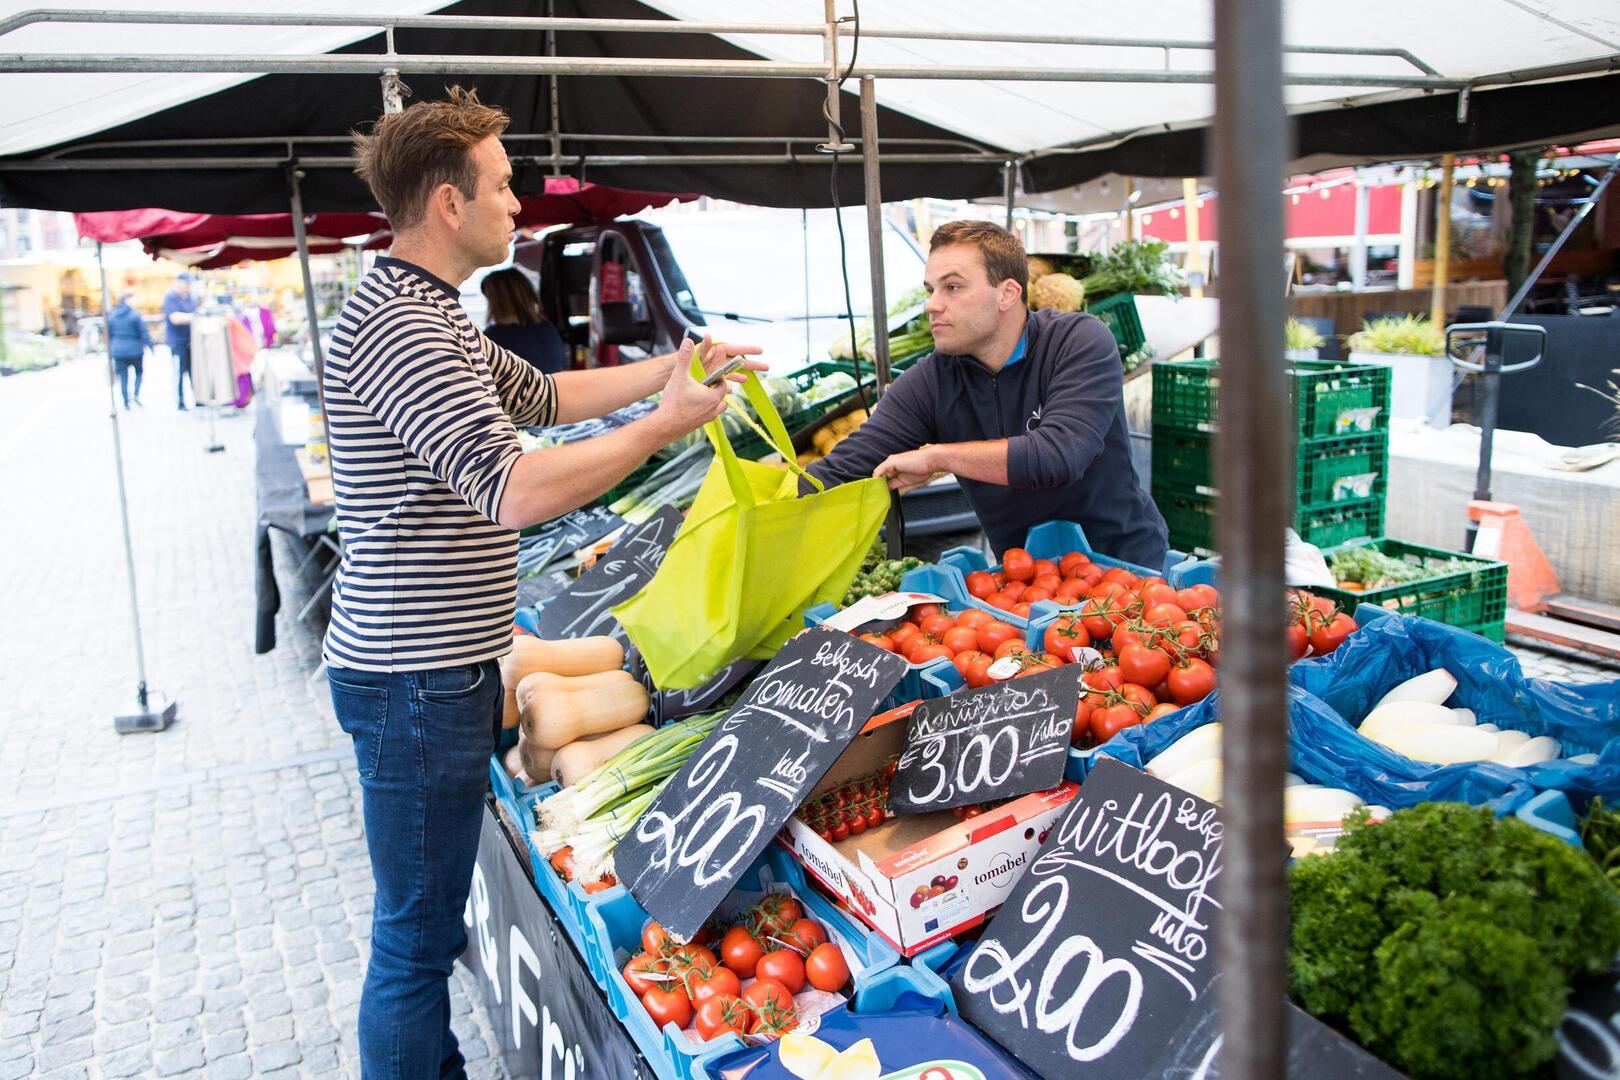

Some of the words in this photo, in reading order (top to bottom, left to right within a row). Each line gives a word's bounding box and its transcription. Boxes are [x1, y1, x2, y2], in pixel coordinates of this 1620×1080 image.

[750, 658, 855, 731] Tomaten
[1039, 786, 1072, 802] tomabel
[801, 843, 844, 888] tomabel
[974, 851, 1028, 886] tomabel
